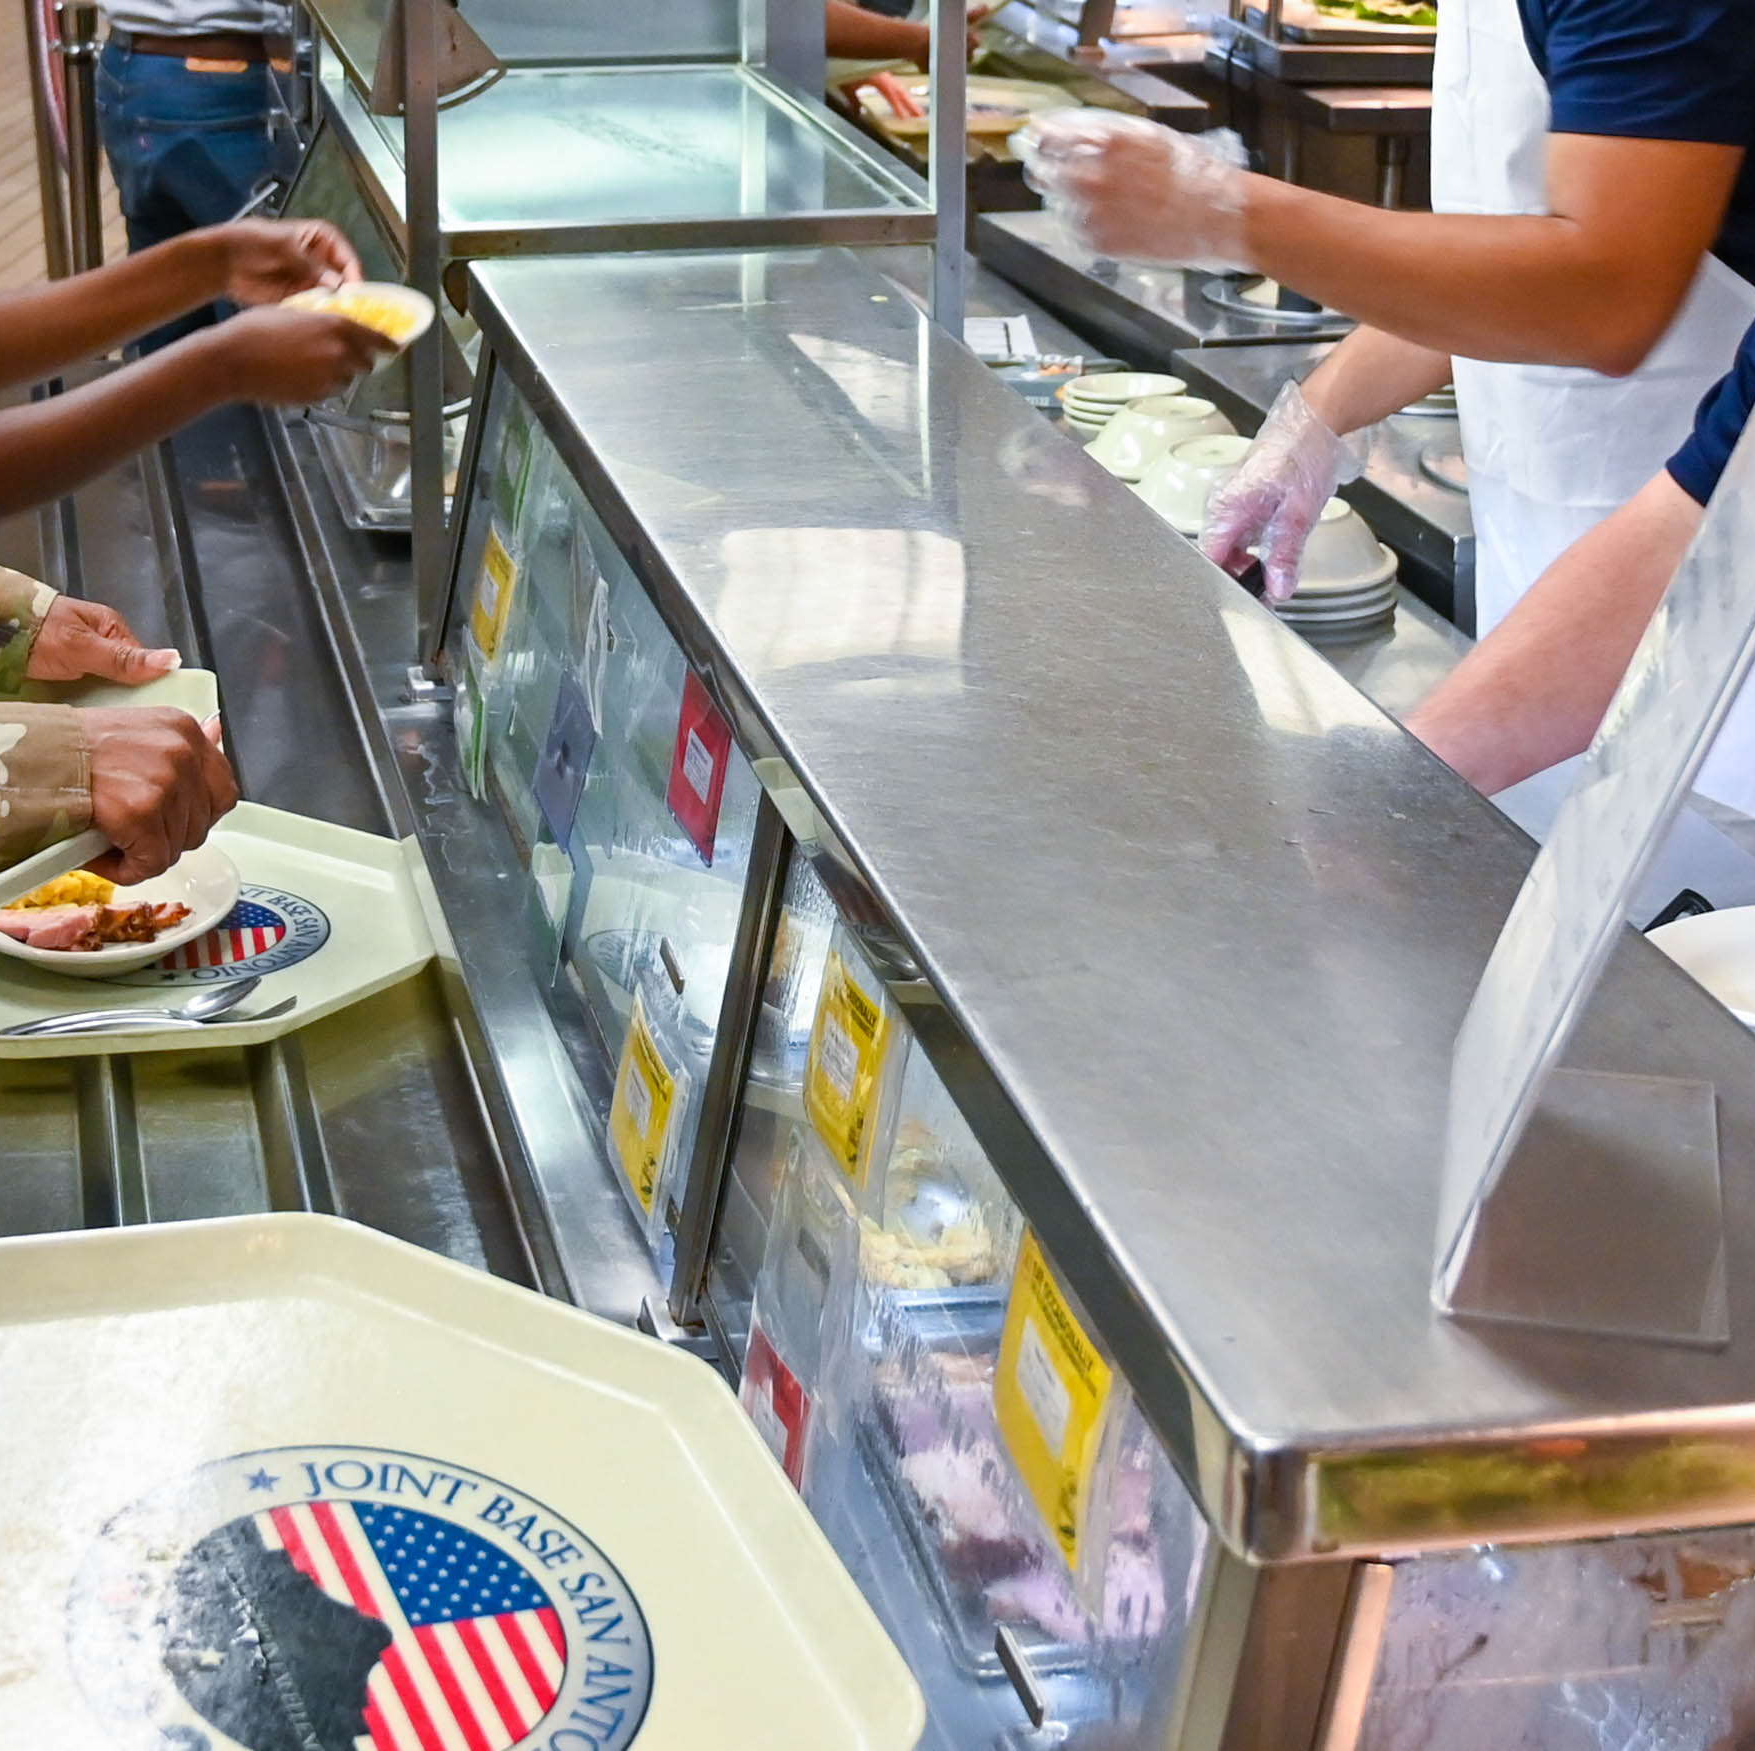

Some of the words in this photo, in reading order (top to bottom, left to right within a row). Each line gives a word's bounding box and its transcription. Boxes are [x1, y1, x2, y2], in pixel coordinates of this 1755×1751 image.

[267, 895, 312, 921] BASE
[293, 917, 321, 940] SAN
[191, 939, 312, 980] ANTONIO
[301, 1460, 478, 1505] JOINT
[476, 1494, 584, 1570] BASE
[558, 1571, 632, 1646] SAN
